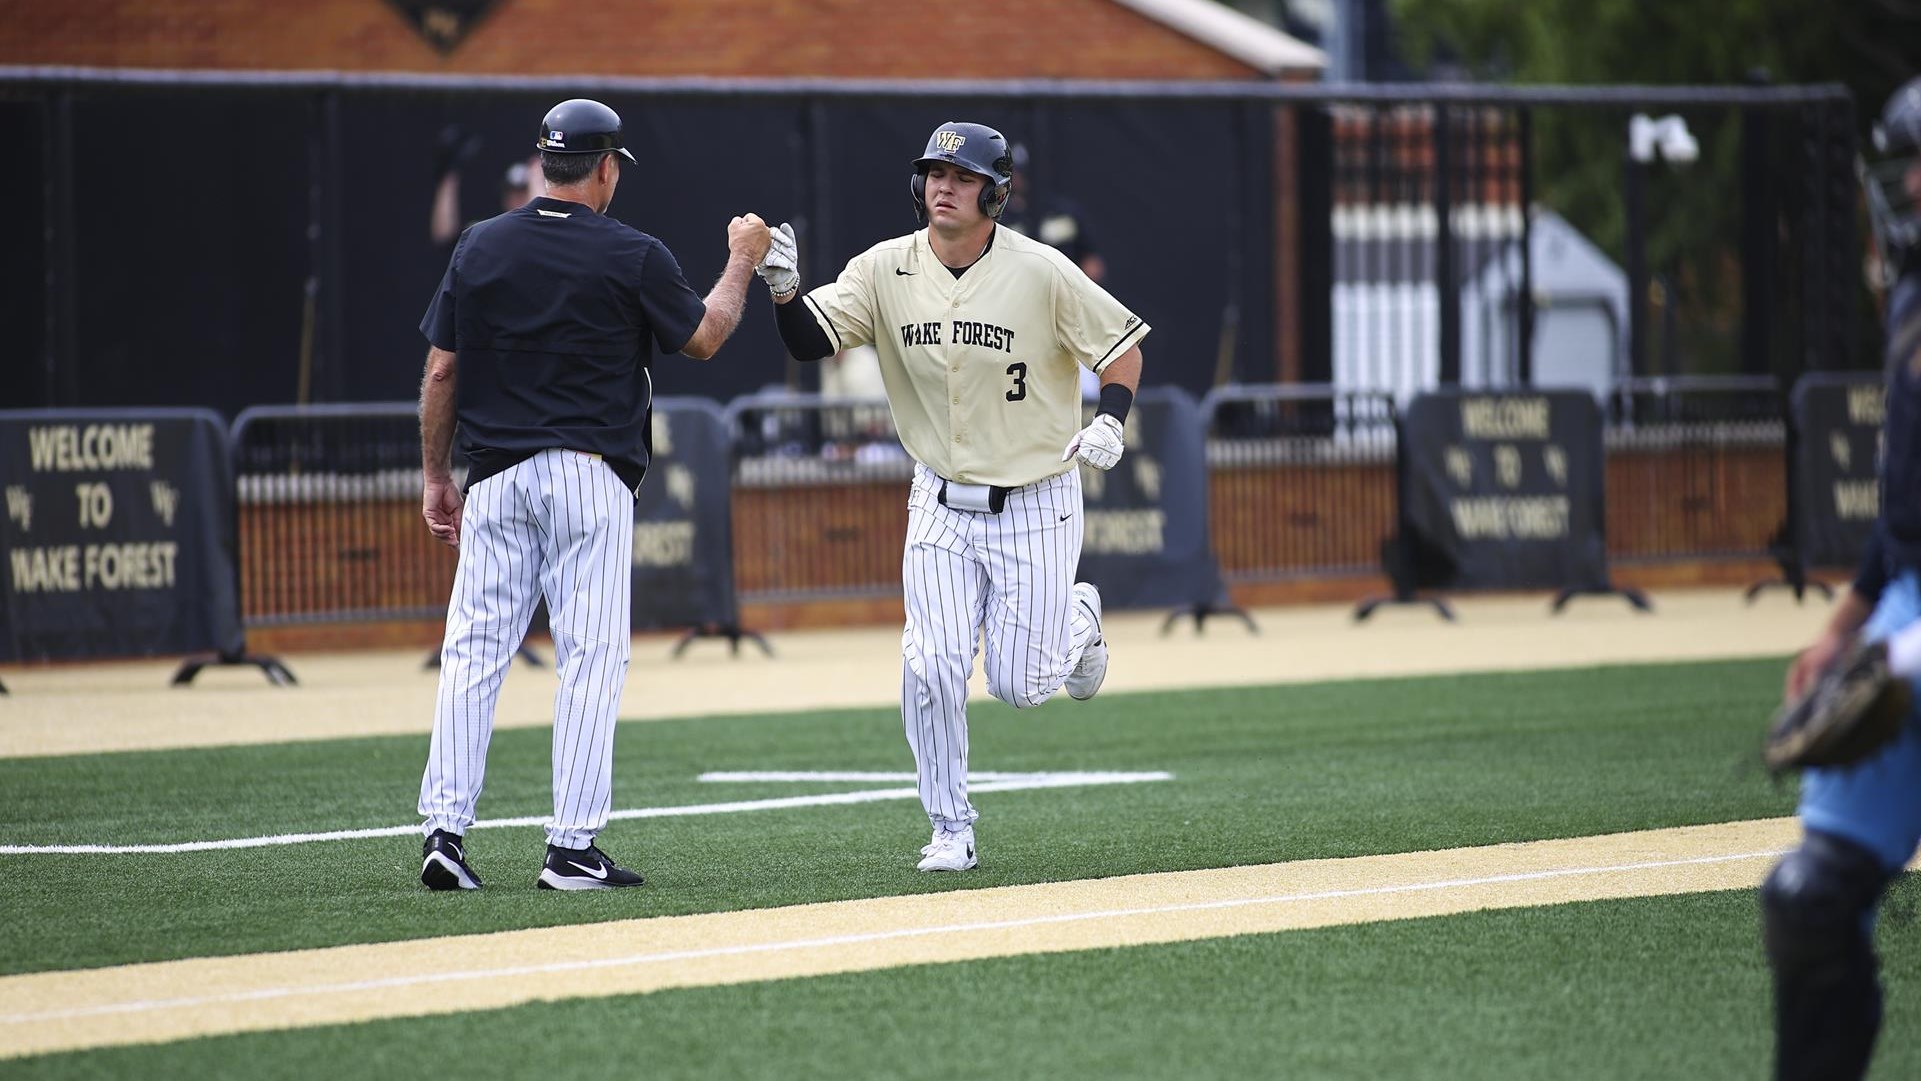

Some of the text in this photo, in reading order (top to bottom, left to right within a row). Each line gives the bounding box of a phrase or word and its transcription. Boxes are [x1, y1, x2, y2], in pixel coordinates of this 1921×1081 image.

[937, 131, 966, 153] WF
[901, 320, 1014, 353] WAKE FOREST
[1005, 361, 1027, 402] 3
[29, 423, 154, 471] WELCOME
[76, 482, 113, 529] TO
[10, 541, 177, 592] WAKE FOREST
